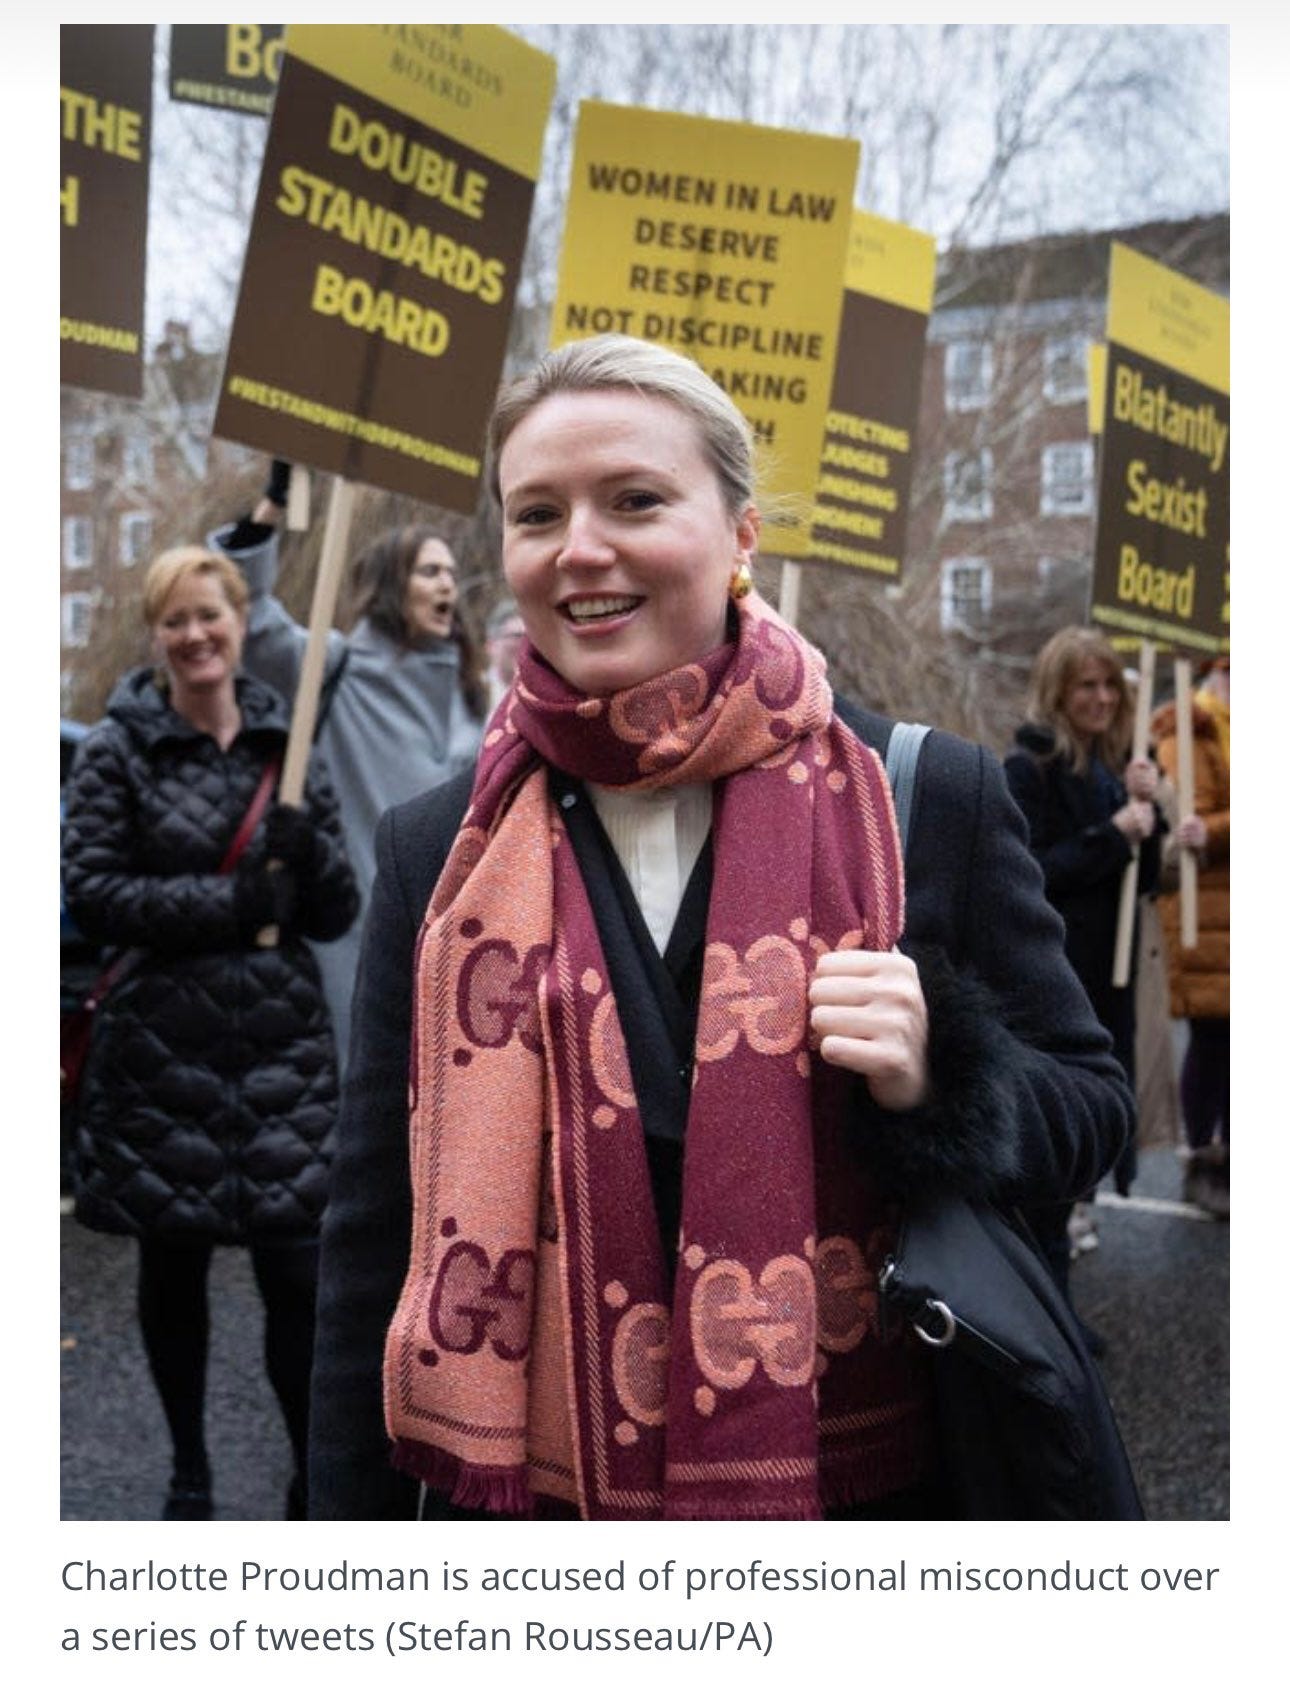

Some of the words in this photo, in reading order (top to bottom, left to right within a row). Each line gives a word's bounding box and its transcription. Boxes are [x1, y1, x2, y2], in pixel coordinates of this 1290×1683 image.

[60, 85, 142, 162] THE
[330, 103, 489, 220] DOUBLE
[588, 163, 718, 207] WOMEN
[725, 183, 760, 213] IN
[768, 188, 837, 223] LAW
[276, 166, 507, 304] STANDARDS
[634, 217, 779, 262] DESERVE
[311, 264, 450, 357] BOARD
[629, 264, 775, 308] RESPECT
[566, 303, 634, 335] NOT
[643, 312, 823, 360] DISCIPLINE
[1113, 364, 1230, 472] Blatantly
[1126, 458, 1208, 537] Sexist
[1118, 543, 1196, 619] Board
